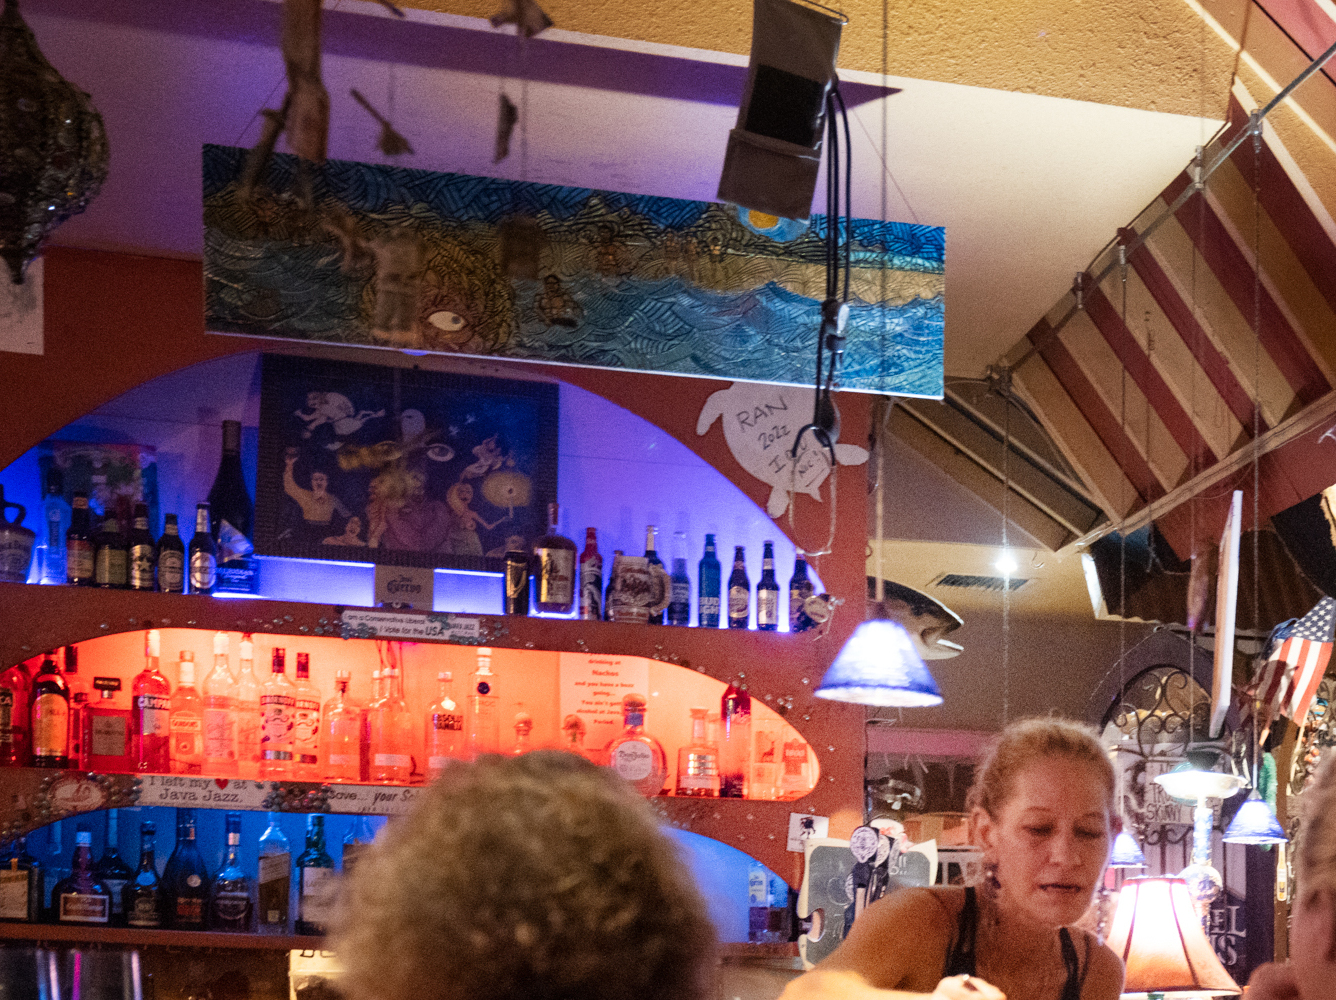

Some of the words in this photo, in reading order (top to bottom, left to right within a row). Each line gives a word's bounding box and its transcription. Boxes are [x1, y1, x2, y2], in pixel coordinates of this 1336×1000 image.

[736, 394, 789, 433] RAN
[758, 425, 791, 450] 2022
[425, 626, 445, 636] USA
[160, 776, 185, 787] left
[190, 777, 210, 790] my
[159, 788, 198, 801] Java
[373, 792, 398, 806] your
